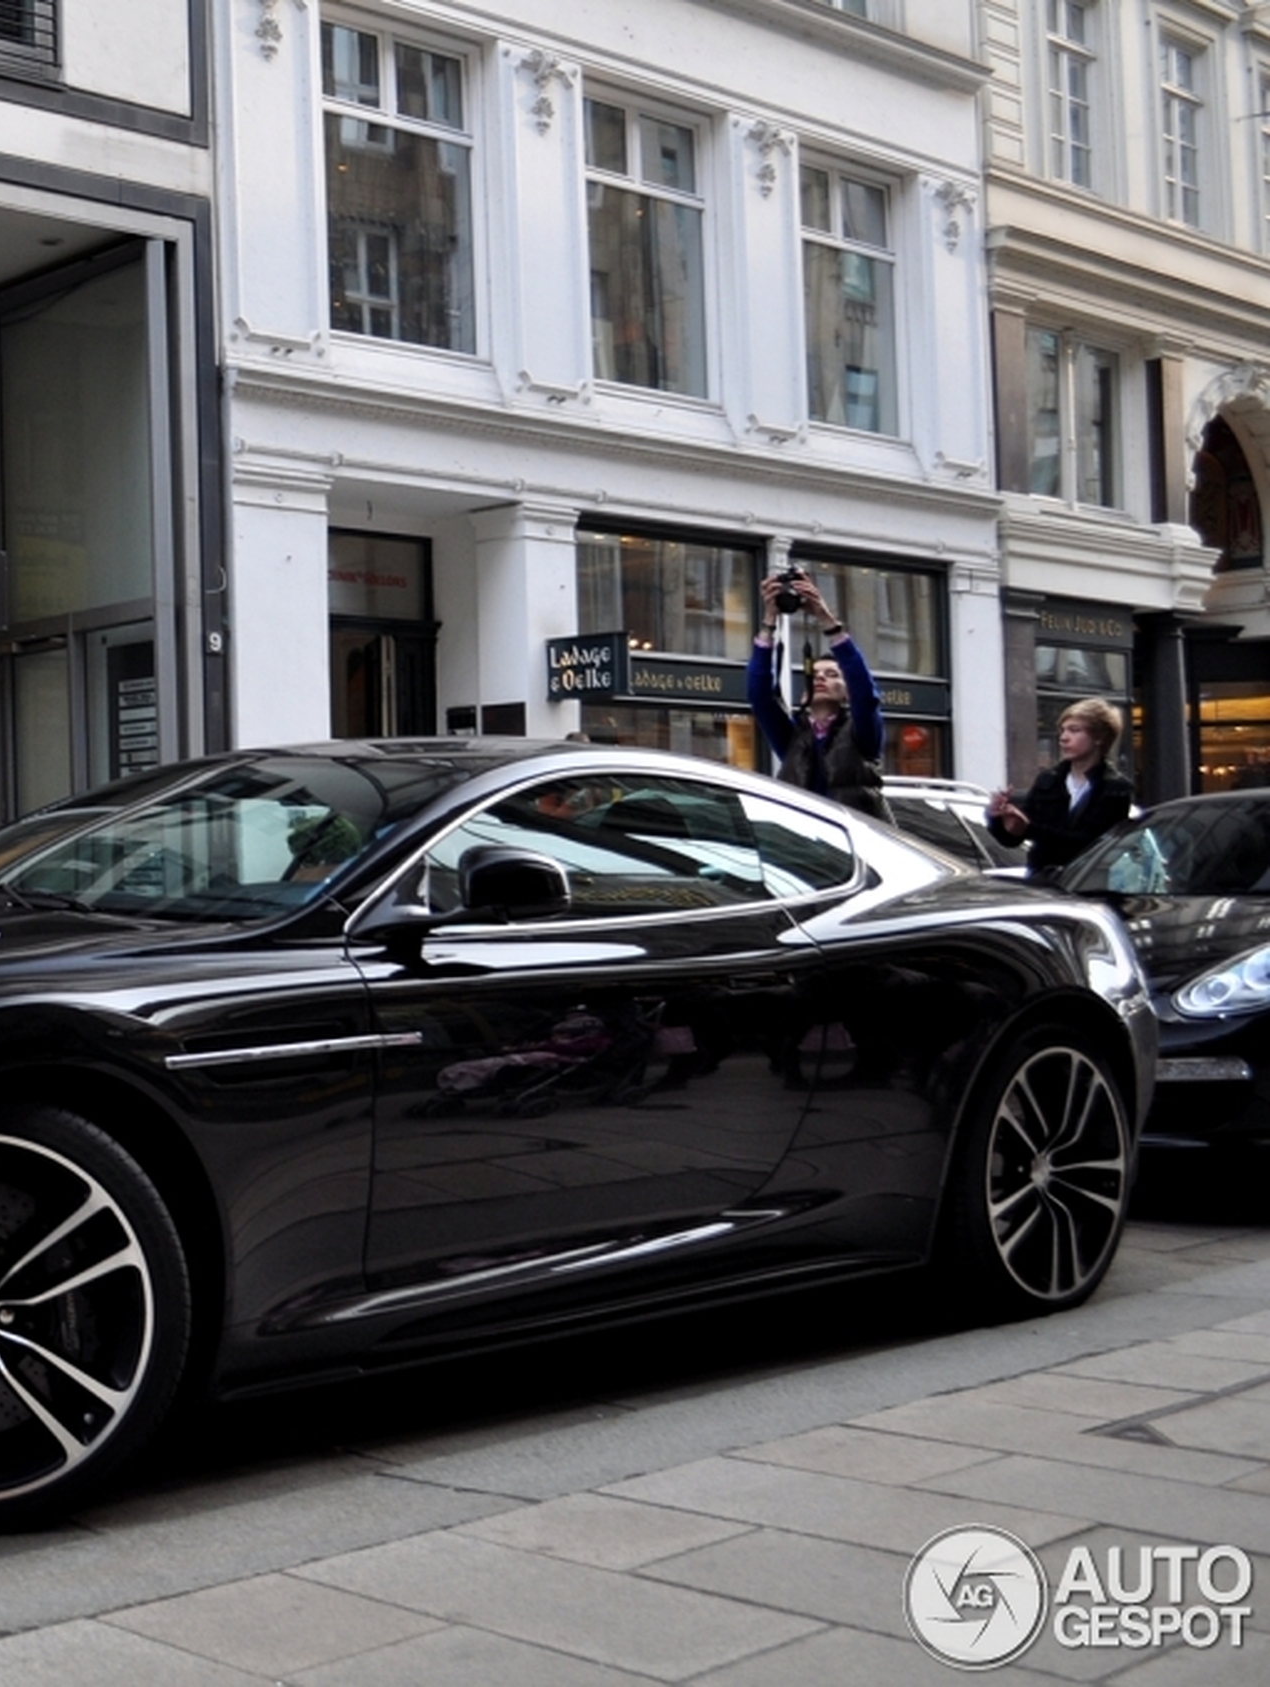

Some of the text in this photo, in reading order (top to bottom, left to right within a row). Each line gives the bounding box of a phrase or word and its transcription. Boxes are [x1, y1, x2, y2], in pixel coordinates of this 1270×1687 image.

[209, 632, 223, 652] 9
[550, 644, 611, 669] Ladage
[562, 669, 612, 690] Oelke
